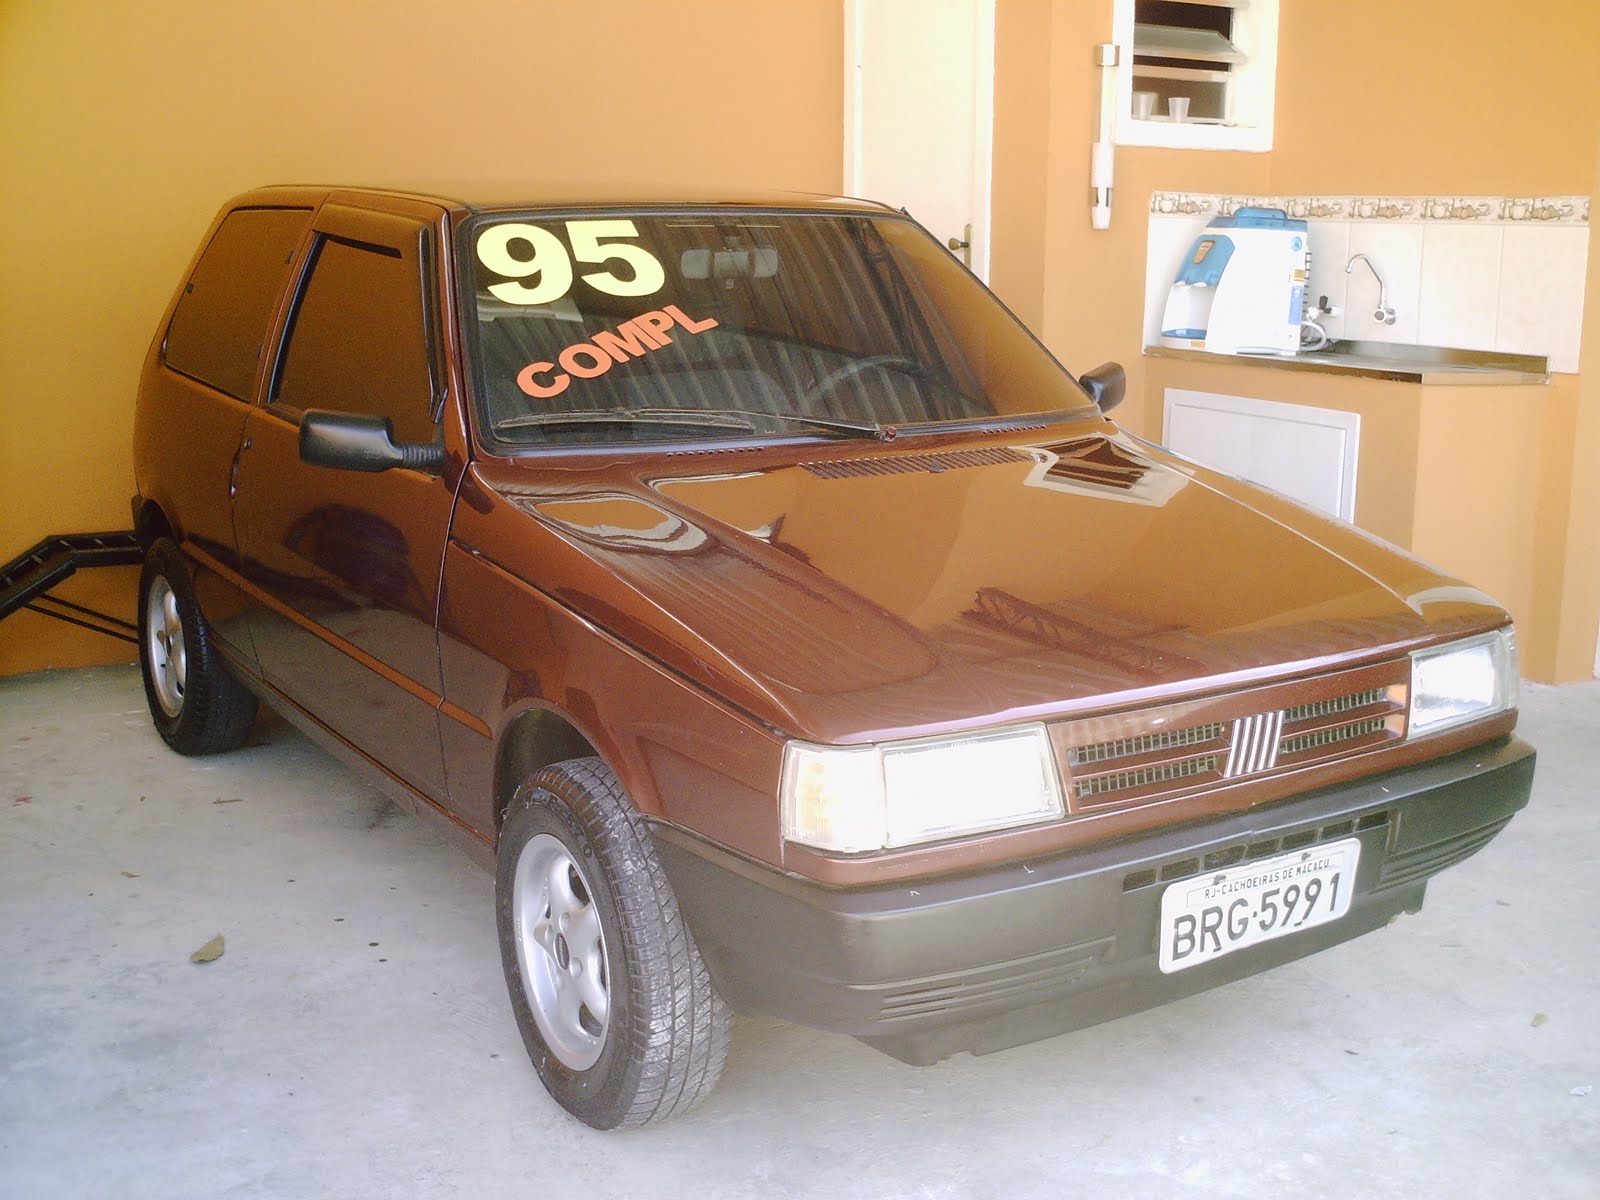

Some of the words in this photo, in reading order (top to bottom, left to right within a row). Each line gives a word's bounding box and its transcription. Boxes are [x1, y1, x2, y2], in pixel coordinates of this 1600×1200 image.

[476, 219, 665, 305] 95
[516, 304, 719, 398] COMPL
[1204, 872, 1280, 899] RJ-CACHOEIRAS
[1282, 868, 1294, 879] DE
[1296, 858, 1330, 876] MACACU
